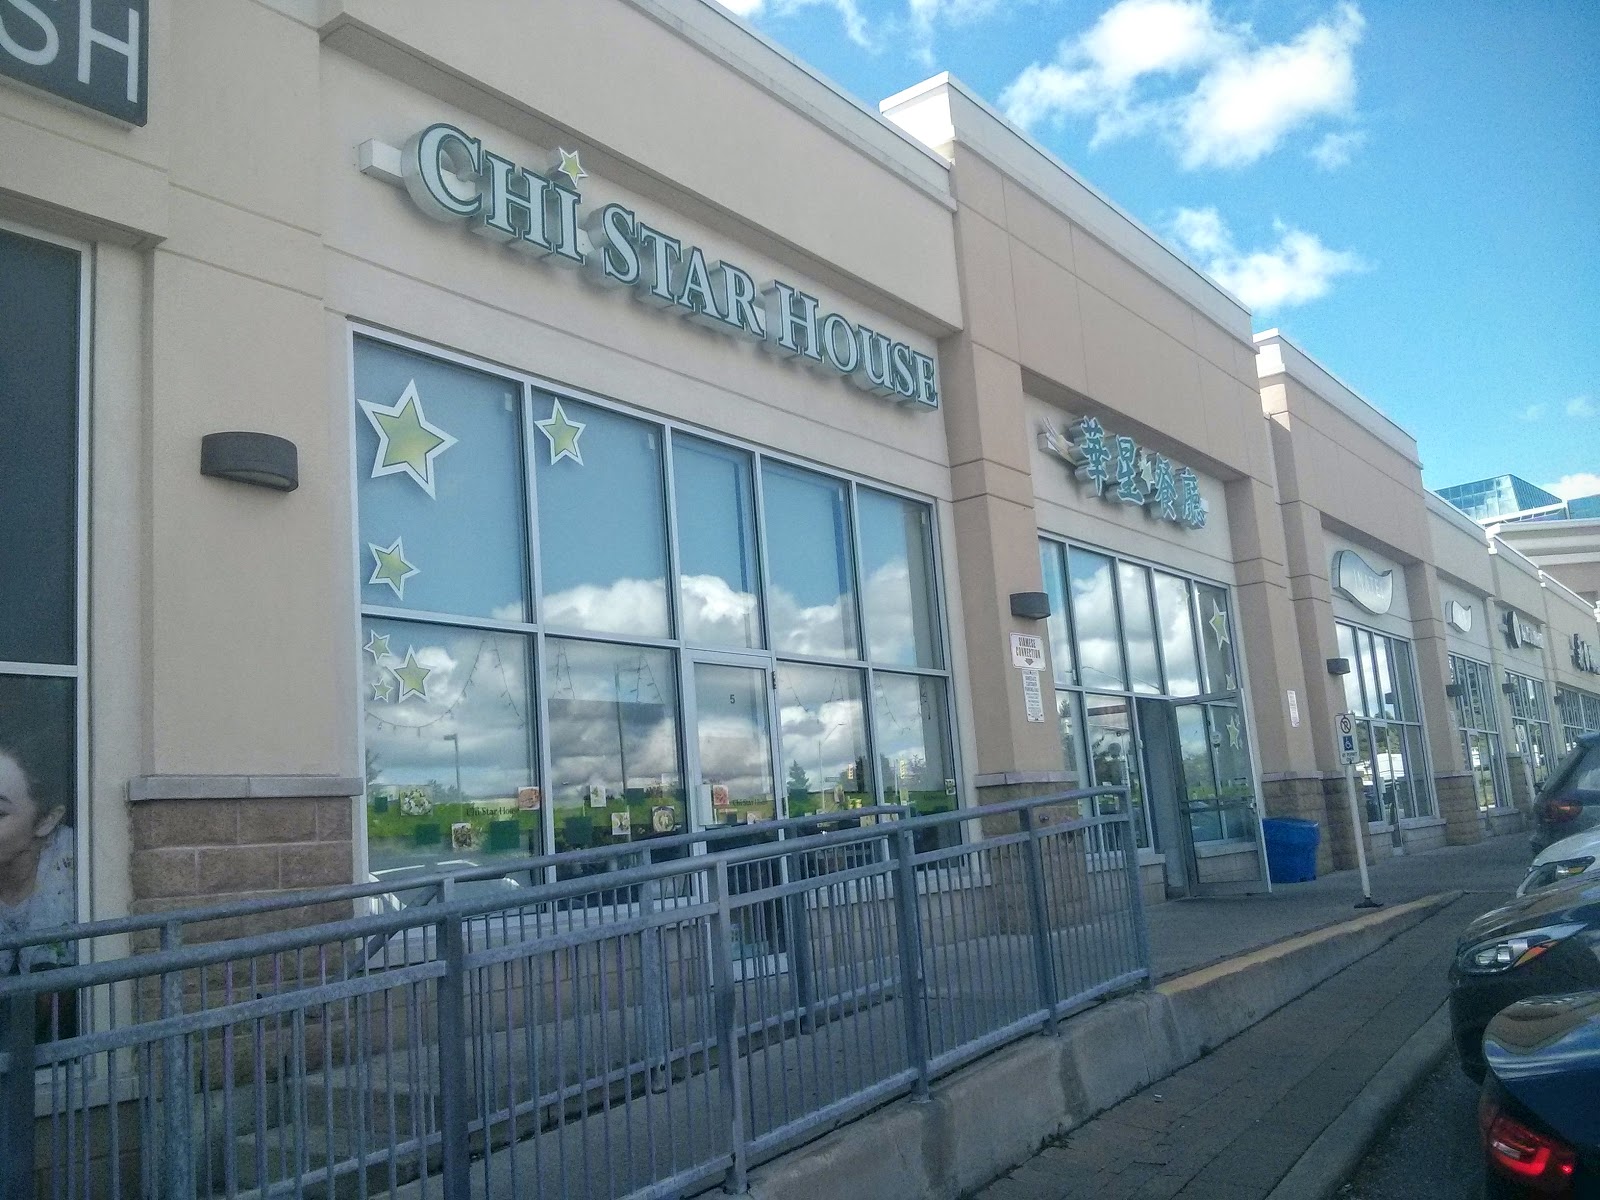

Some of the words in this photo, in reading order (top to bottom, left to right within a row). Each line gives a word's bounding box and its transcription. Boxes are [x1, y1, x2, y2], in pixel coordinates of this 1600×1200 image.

[415, 122, 586, 265] CHI
[600, 202, 767, 339] STAR
[773, 279, 939, 411] HOUSE
[1015, 646, 1040, 659] CONNECTION
[730, 694, 735, 704] 5
